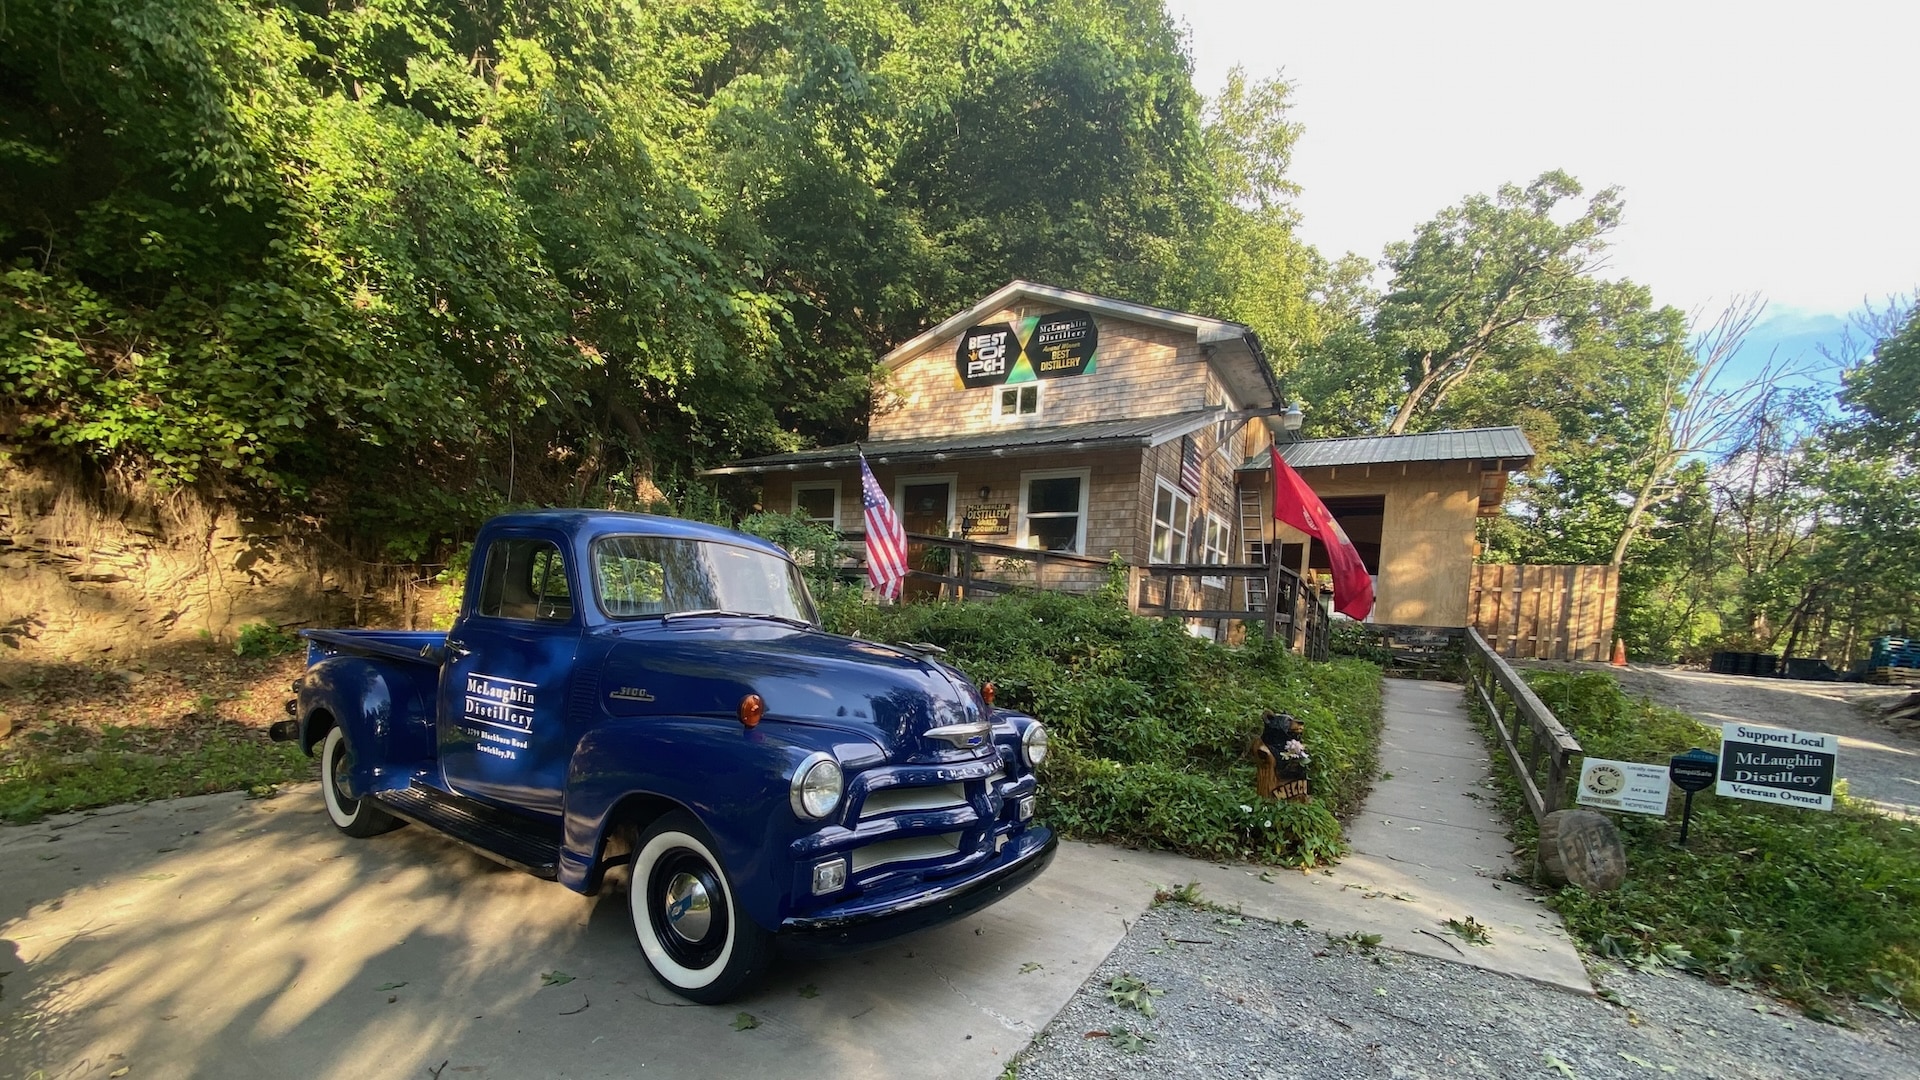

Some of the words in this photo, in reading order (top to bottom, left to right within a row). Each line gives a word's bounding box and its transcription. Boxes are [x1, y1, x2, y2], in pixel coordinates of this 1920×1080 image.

[1040, 321, 1087, 333] McLaughlin
[968, 331, 1007, 350] BEST
[1039, 330, 1086, 342] Distillery
[978, 345, 1006, 361] OF
[1051, 349, 1070, 361] BEST
[968, 357, 1006, 374] PGH
[1040, 356, 1081, 372] DISTILLERY
[967, 509, 1010, 520] DISTILLERY
[466, 678, 535, 704] McLaughlin
[465, 699, 533, 730] Distillery
[481, 730, 511, 745] Blackburn
[512, 737, 528, 749] Road
[1737, 726, 1789, 744] Support
[1791, 733, 1825, 748] Local
[1735, 752, 1822, 770] McLaughlin
[1734, 770, 1821, 787] Distillery
[1731, 784, 1777, 798] Veteran
[1780, 791, 1823, 805] Owned
